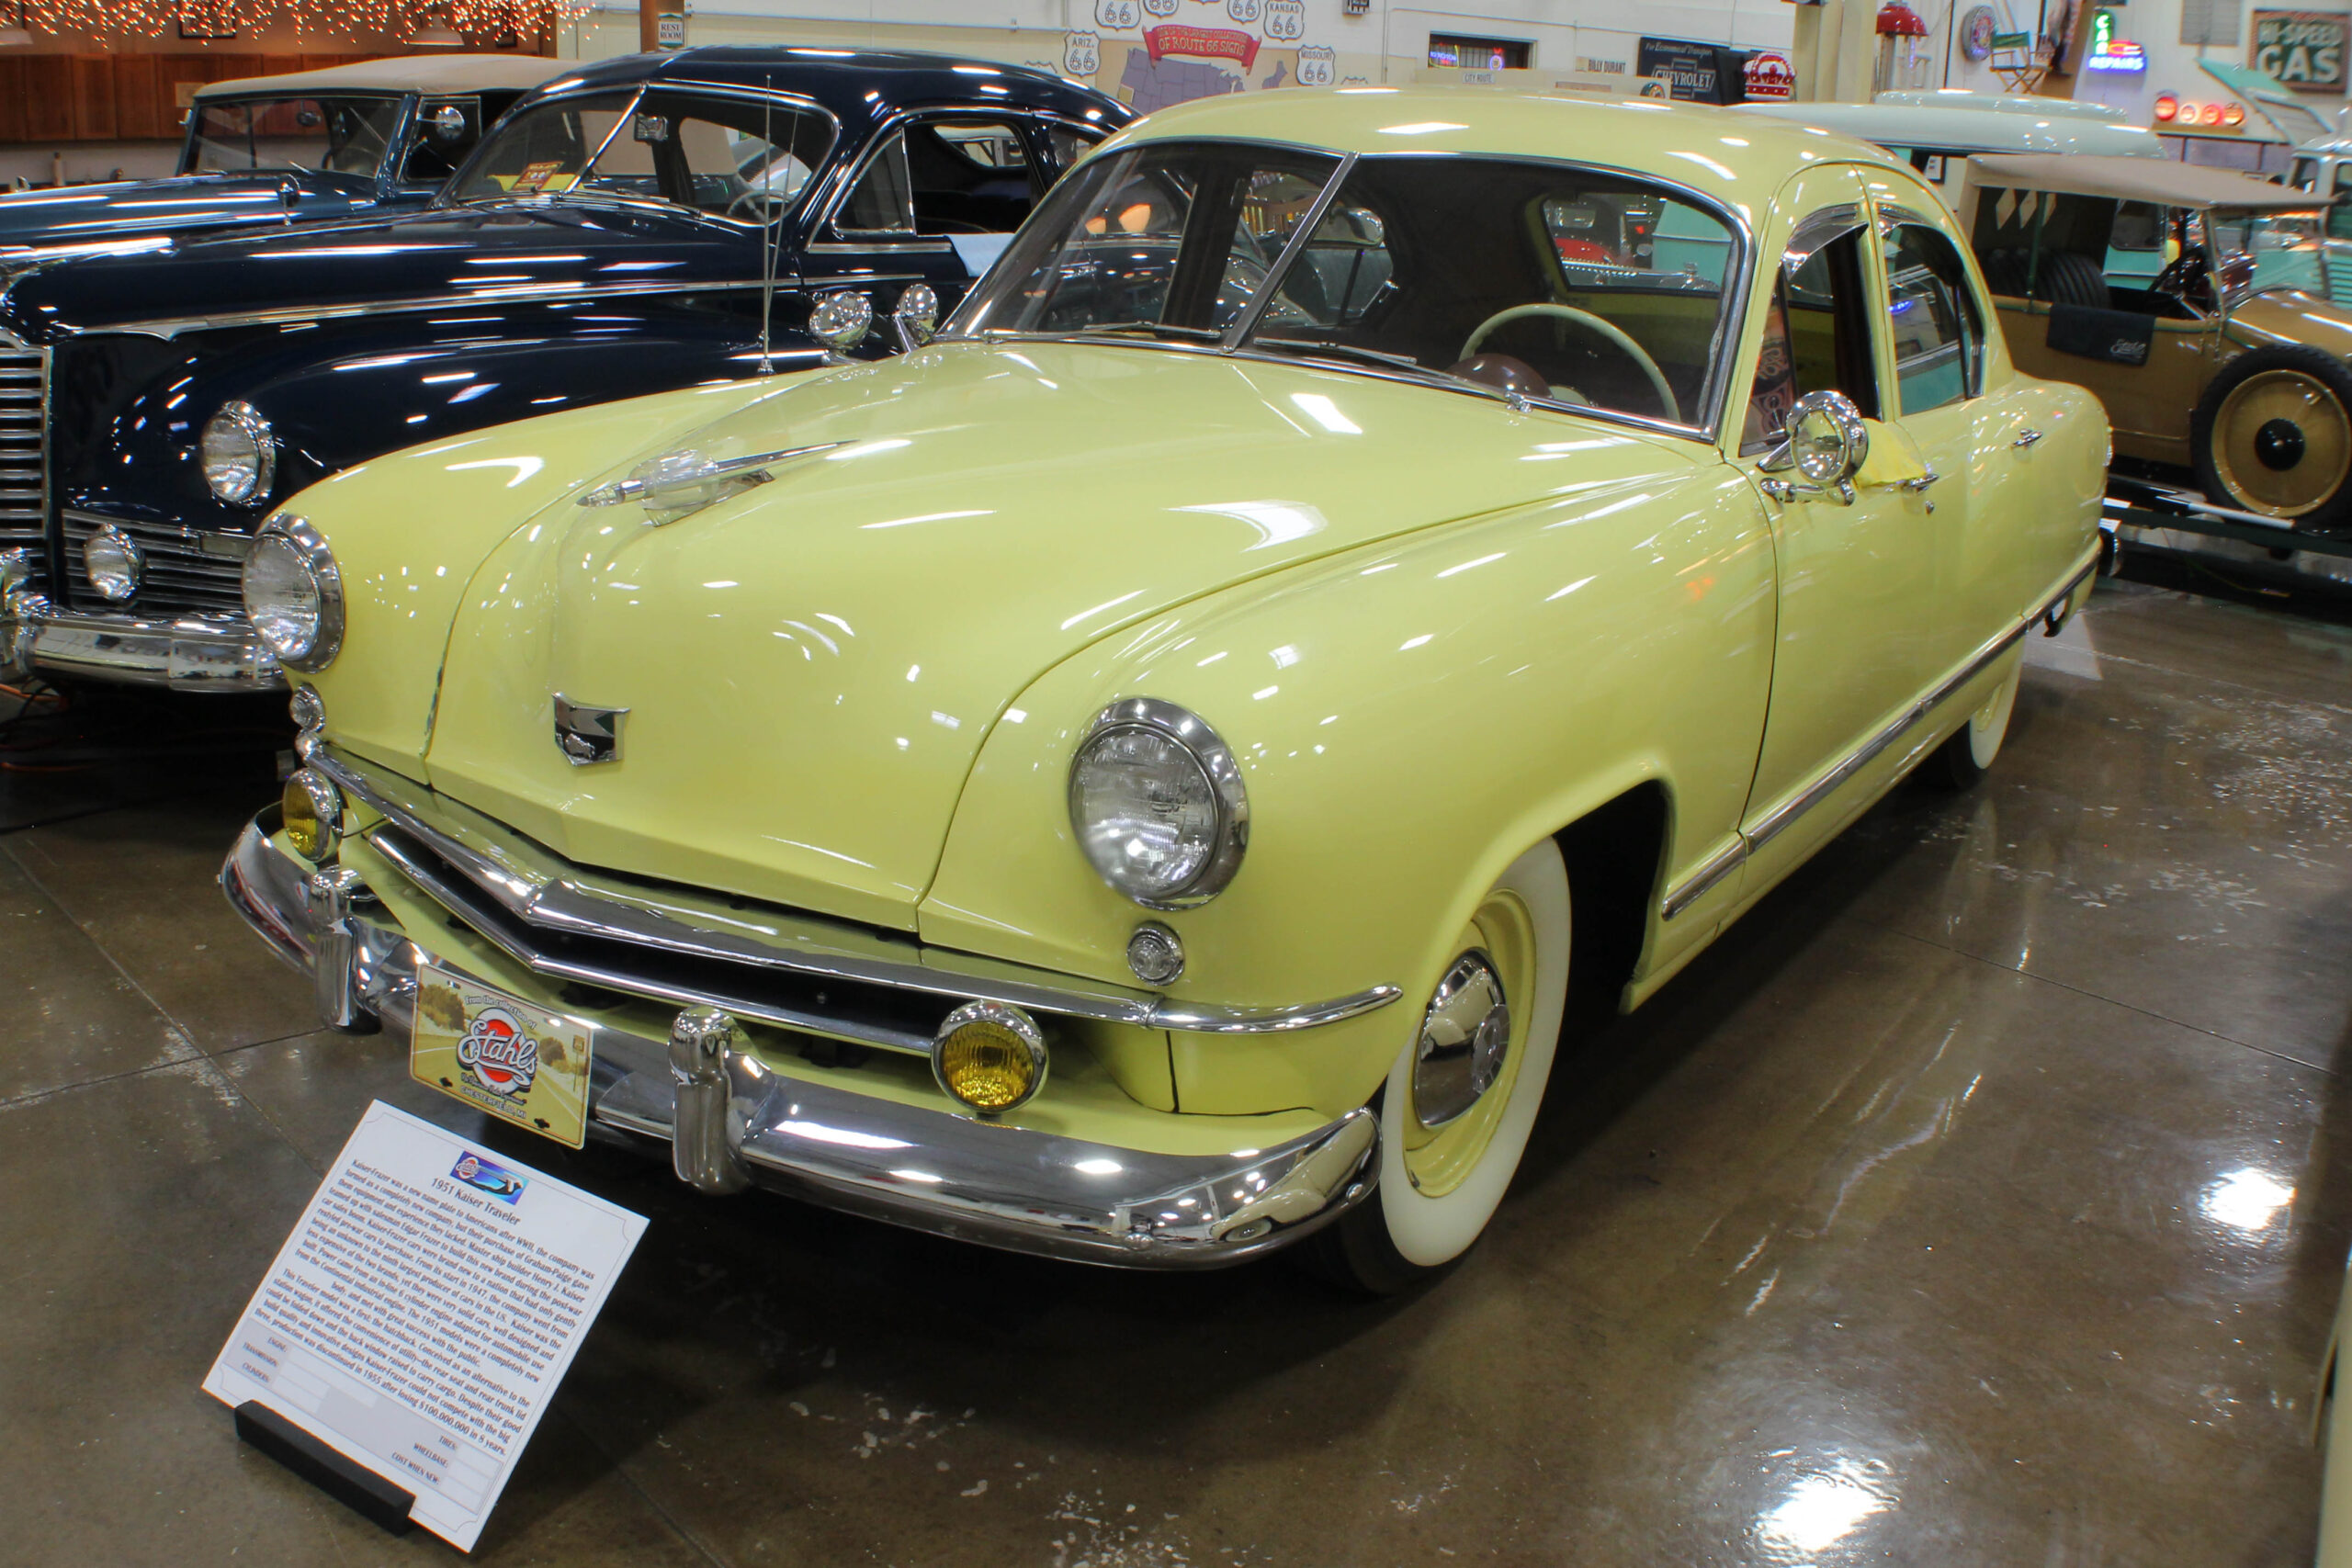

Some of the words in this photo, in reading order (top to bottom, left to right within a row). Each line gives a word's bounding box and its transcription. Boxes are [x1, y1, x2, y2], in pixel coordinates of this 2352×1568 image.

[1105, 1, 1131, 24] 66
[1270, 3, 1299, 13] KANSAS
[1272, 14, 1296, 35] 66
[1072, 38, 1095, 48] ARIZ.
[1159, 38, 1170, 51] OF
[1172, 37, 1205, 51] ROUTE
[1206, 40, 1218, 51] 66
[1219, 41, 1246, 55] SIGNS
[1301, 50, 1332, 61] MISSOURI
[2258, 22, 2343, 45] HI-SPEED
[1069, 49, 1095, 71] 66
[1304, 61, 1328, 82] 66
[1588, 59, 1603, 73] BILLY
[1603, 61, 1626, 73] DURANT
[1655, 69, 1712, 88] CHEVROLET
[2088, 56, 2144, 71] REPAIRS
[2256, 44, 2341, 84] GAS
[465, 996, 482, 1005] From
[483, 995, 496, 1006] the
[496, 998, 528, 1022] collection
[526, 1019, 537, 1030] of
[457, 1018, 538, 1086] Stahls
[460, 1085, 516, 1115] CHESTERFIELD,
[517, 1109, 527, 1119] MI
[431, 1178, 454, 1194] 1951
[454, 1189, 484, 1209] Kaiser
[483, 1202, 521, 1225] Traveler
[466, 1254, 480, 1266] this
[479, 1262, 493, 1272] new
[493, 1268, 515, 1283] brand
[514, 1278, 539, 1296] during
[538, 1290, 552, 1301] the
[482, 1235, 515, 1257] purchase
[514, 1250, 525, 1259] of
[523, 1254, 572, 1284] Graham-Paige
[571, 1279, 589, 1292] gave
[490, 1252, 507, 1266] ship
[506, 1259, 532, 1277] builder
[531, 1271, 554, 1289] Henry
[560, 1286, 585, 1303] Kaiser
[498, 1228, 516, 1242] after
[536, 1246, 548, 1257] the
[547, 1254, 580, 1273] company
[580, 1269, 594, 1280] was
[450, 1288, 459, 1297] of
[458, 1293, 475, 1305] cars
[475, 1300, 484, 1310] in
[483, 1304, 496, 1315] the
[495, 1311, 508, 1322] US.
[510, 1318, 535, 1336] Kaiser
[534, 1332, 548, 1343] was
[548, 1337, 562, 1349] the
[458, 1278, 468, 1287] in
[467, 1282, 489, 1300] 1947,
[489, 1293, 502, 1304] the
[500, 1301, 532, 1322] company
[532, 1314, 550, 1329] went
[549, 1324, 569, 1338] from
[471, 1270, 481, 1280] to
[486, 1278, 509, 1294] nation
[509, 1289, 525, 1302] that
[524, 1296, 538, 1309] had
[537, 1303, 555, 1318] only
[553, 1312, 577, 1329] gently
[431, 1334, 447, 1347] with
[446, 1342, 459, 1353] the
[458, 1348, 482, 1368] public.
[441, 1299, 457, 1312] very
[457, 1305, 475, 1319] solid
[473, 1315, 492, 1330] cars,
[492, 1324, 508, 1337] well
[506, 1331, 539, 1354] designed
[539, 1348, 555, 1360] and
[452, 1317, 481, 1338] adapted
[480, 1331, 492, 1343] for
[492, 1337, 531, 1363] automobile
[530, 1359, 544, 1371] use
[418, 1341, 452, 1365] Conceived
[451, 1361, 460, 1371] as
[460, 1367, 470, 1376] an
[471, 1371, 509, 1396] alternative
[508, 1391, 518, 1401] to
[517, 1395, 531, 1407] the
[438, 1325, 464, 1343] models
[463, 1339, 481, 1352] were
[486, 1349, 525, 1376] completely
[525, 1371, 539, 1382] new
[407, 1380, 427, 1395] could
[426, 1391, 440, 1403] not
[437, 1397, 469, 1421] compete
[469, 1414, 485, 1428] with
[484, 1423, 498, 1436] the
[496, 1430, 510, 1444] big
[408, 1366, 417, 1375] to
[415, 1372, 435, 1387] carry
[434, 1382, 457, 1400] cargo.
[457, 1393, 485, 1415] Despite
[484, 1407, 503, 1423] their
[501, 1417, 521, 1435] good
[433, 1366, 448, 1378] rear
[448, 1372, 465, 1387] seat
[464, 1382, 479, 1394] and
[478, 1391, 494, 1404] rear
[494, 1398, 515, 1415] trunk
[514, 1409, 526, 1420] lid
[396, 1388, 419, 1406] losing
[469, 1428, 479, 1439] in
[483, 1439, 506, 1457] years.
